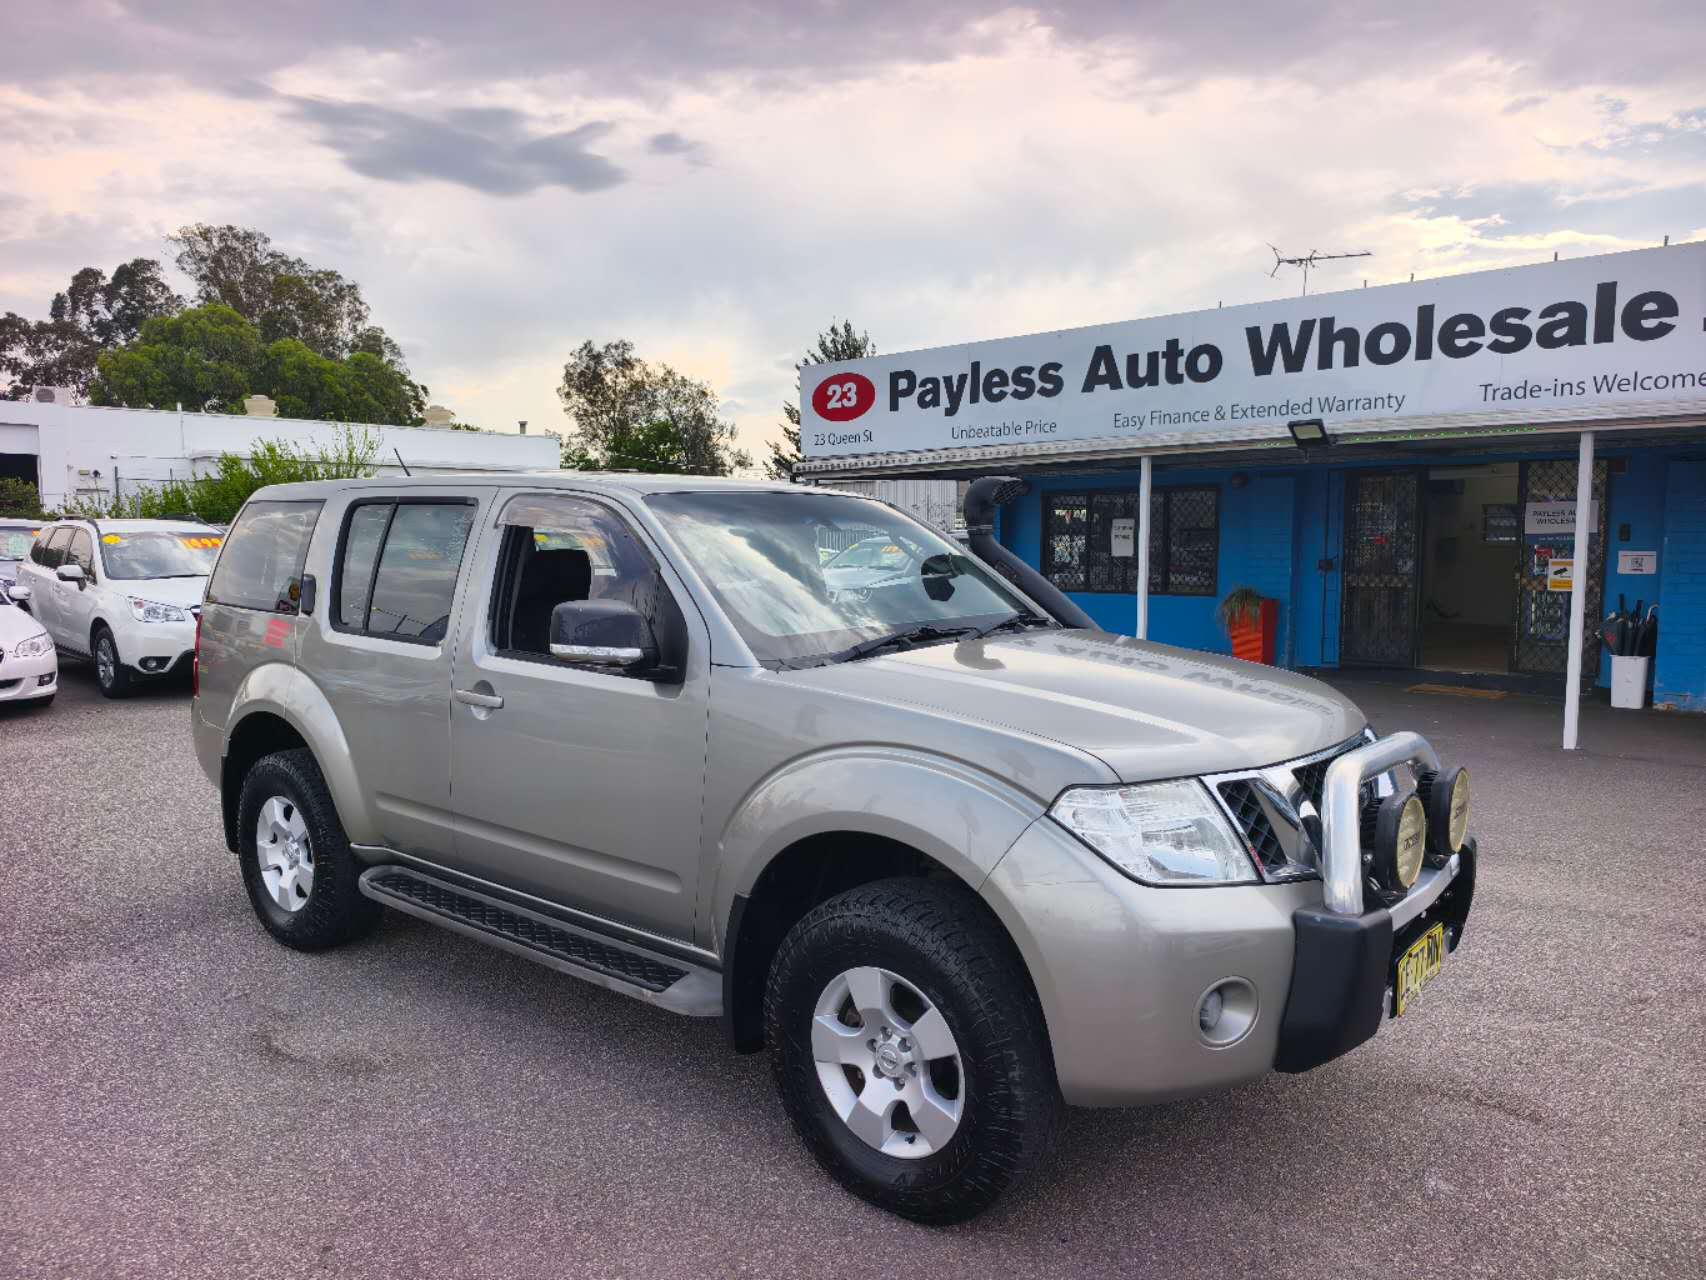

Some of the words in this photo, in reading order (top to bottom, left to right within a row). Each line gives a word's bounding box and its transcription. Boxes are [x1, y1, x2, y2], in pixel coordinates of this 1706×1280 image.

[889, 361, 1065, 417] Payless
[1081, 338, 1223, 393] Auto
[1245, 281, 1680, 377] Wholesale
[826, 382, 857, 409] 23
[1480, 379, 1586, 402] Trade-ins
[1593, 371, 1706, 394] Welcome
[1113, 413, 1146, 430] Easy
[1150, 409, 1210, 426] Finance
[1214, 404, 1226, 421] &
[1231, 396, 1313, 420] Extended
[1318, 392, 1406, 415] Warranty
[814, 432, 832, 446] 23
[827, 431, 861, 447] Queen
[951, 419, 1022, 440] Unbeatable
[1025, 420, 1057, 435] Price
